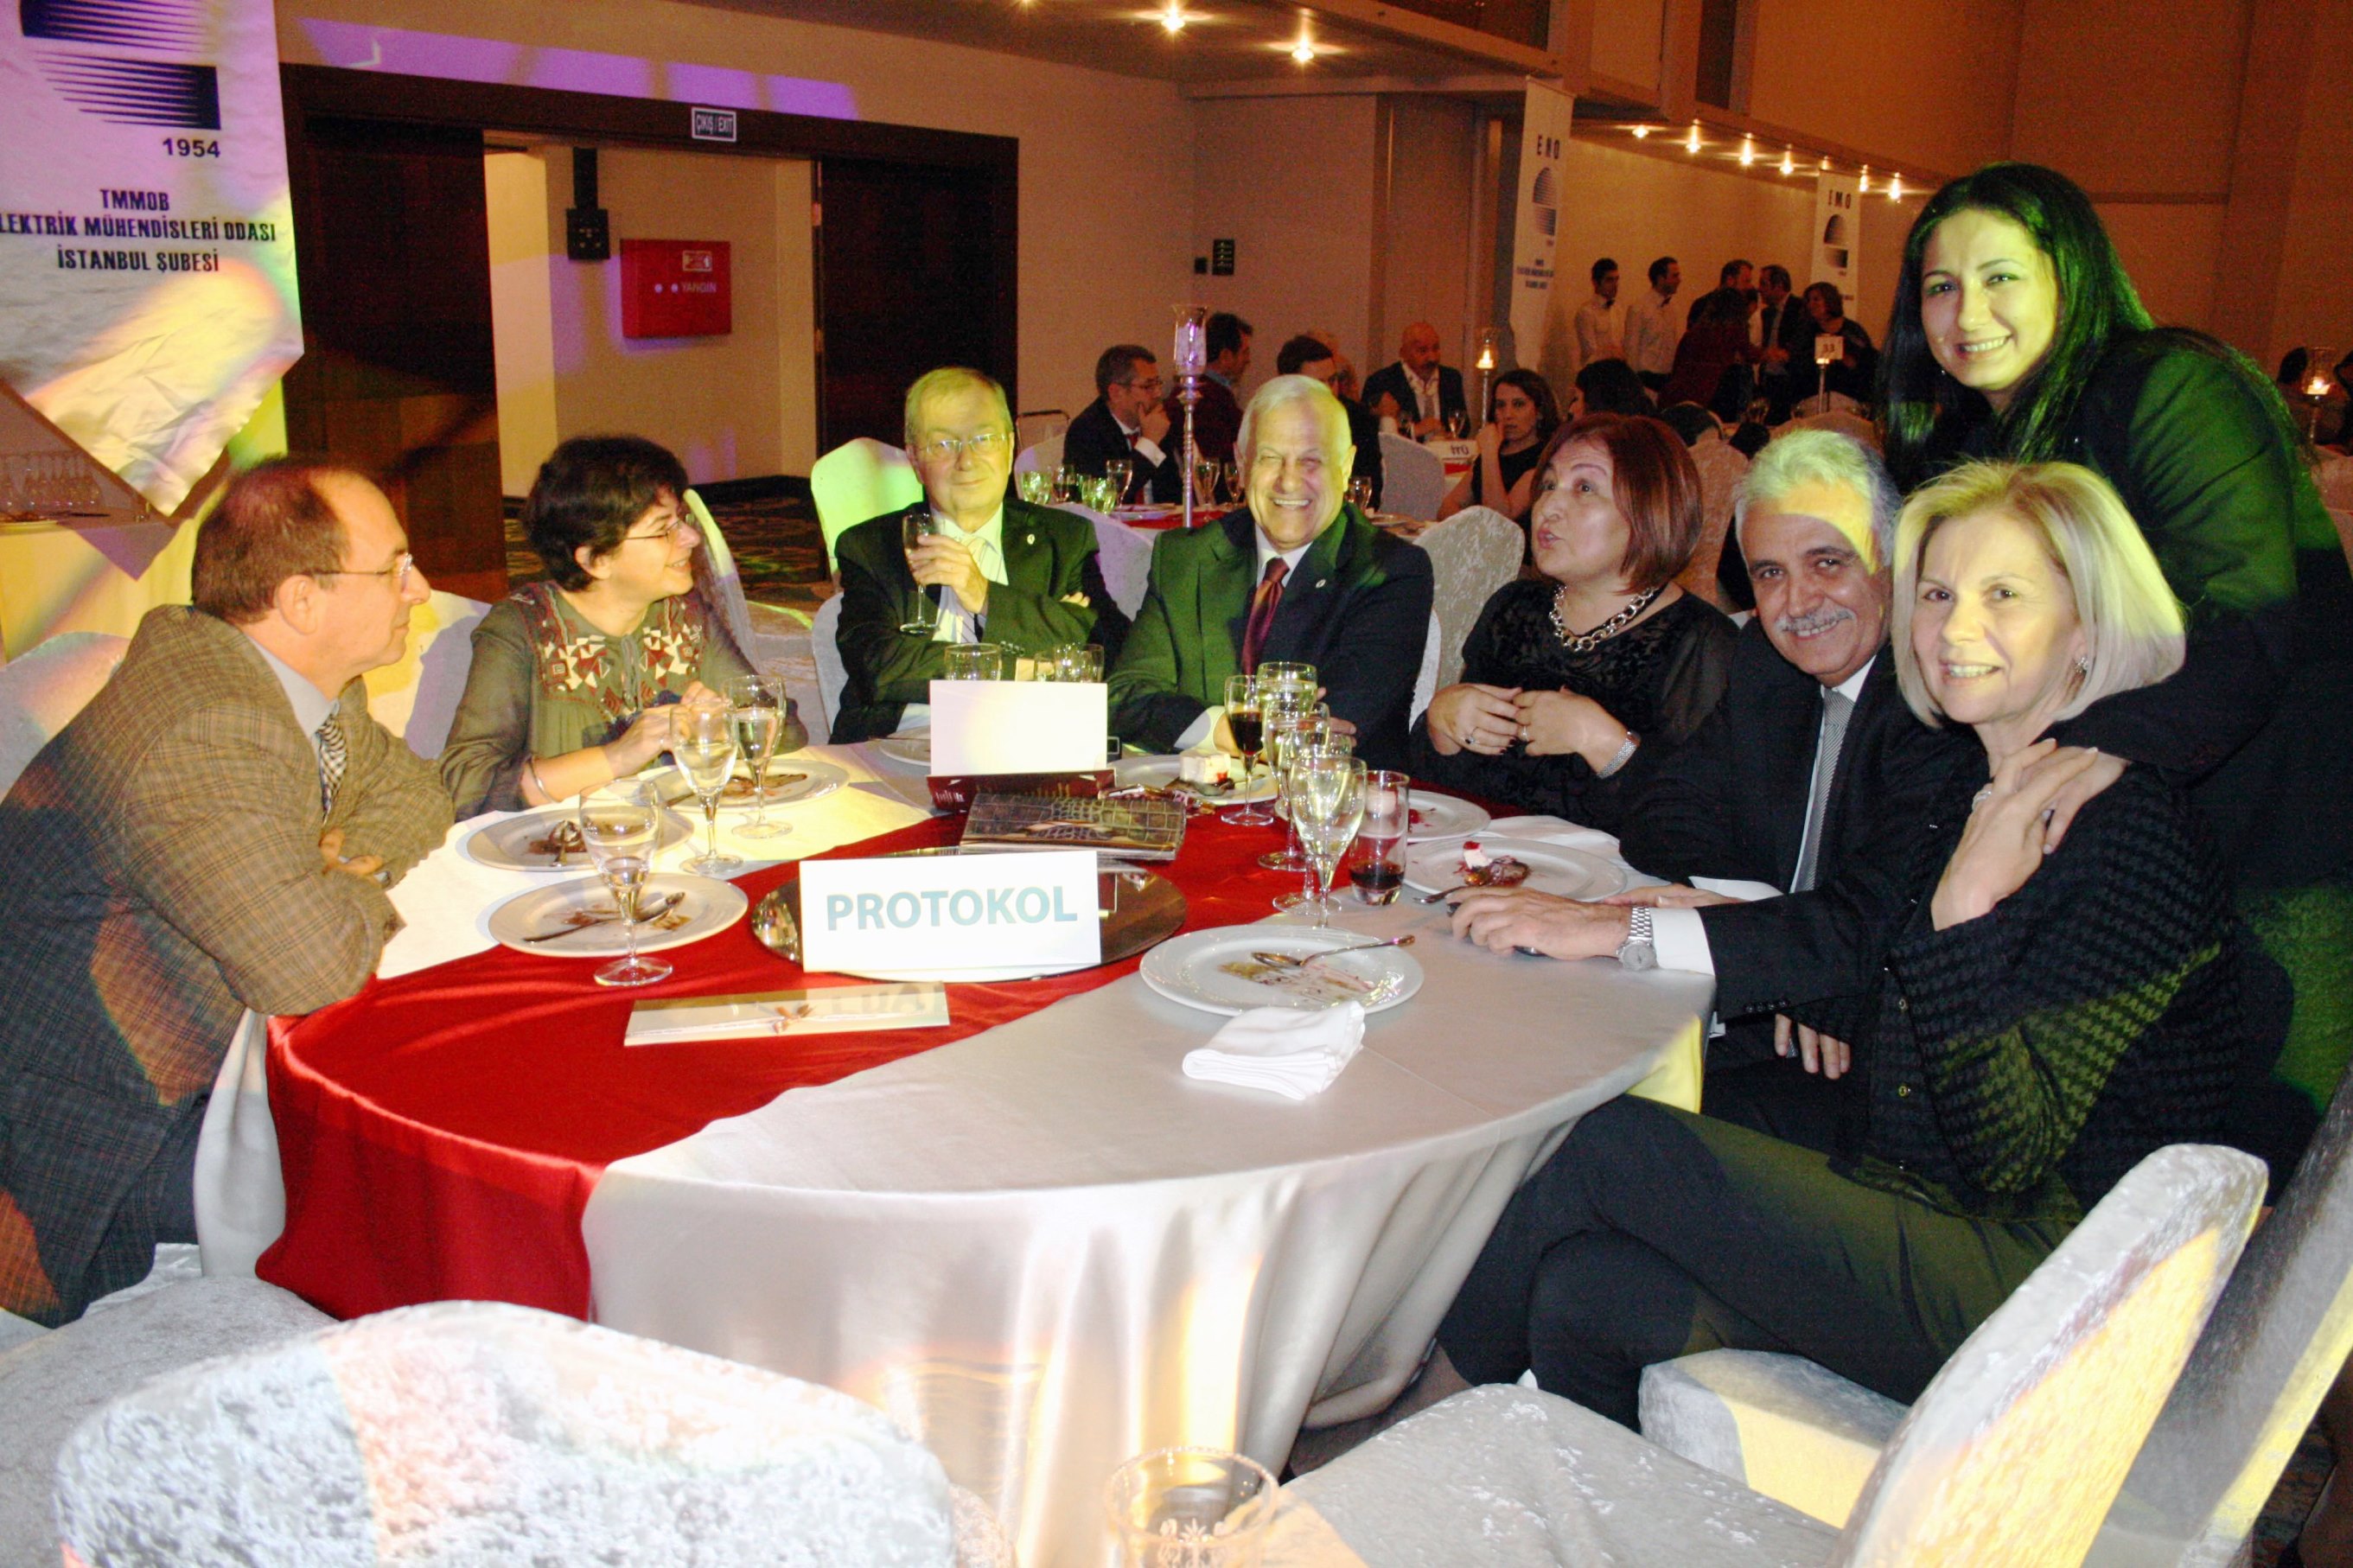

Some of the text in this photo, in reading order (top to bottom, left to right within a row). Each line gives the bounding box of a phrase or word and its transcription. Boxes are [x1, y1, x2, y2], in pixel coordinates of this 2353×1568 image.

[718, 116, 733, 132] EXIT
[162, 137, 221, 158] 1954
[99, 188, 170, 211] TMMOB
[85, 214, 219, 240] MÜHENDİSLERİ
[225, 221, 277, 242] ODASI
[58, 245, 219, 273] İSTANBUL ŞUBESİ
[681, 282, 717, 293] YANGIN
[826, 885, 1078, 932] PROTOKOL
